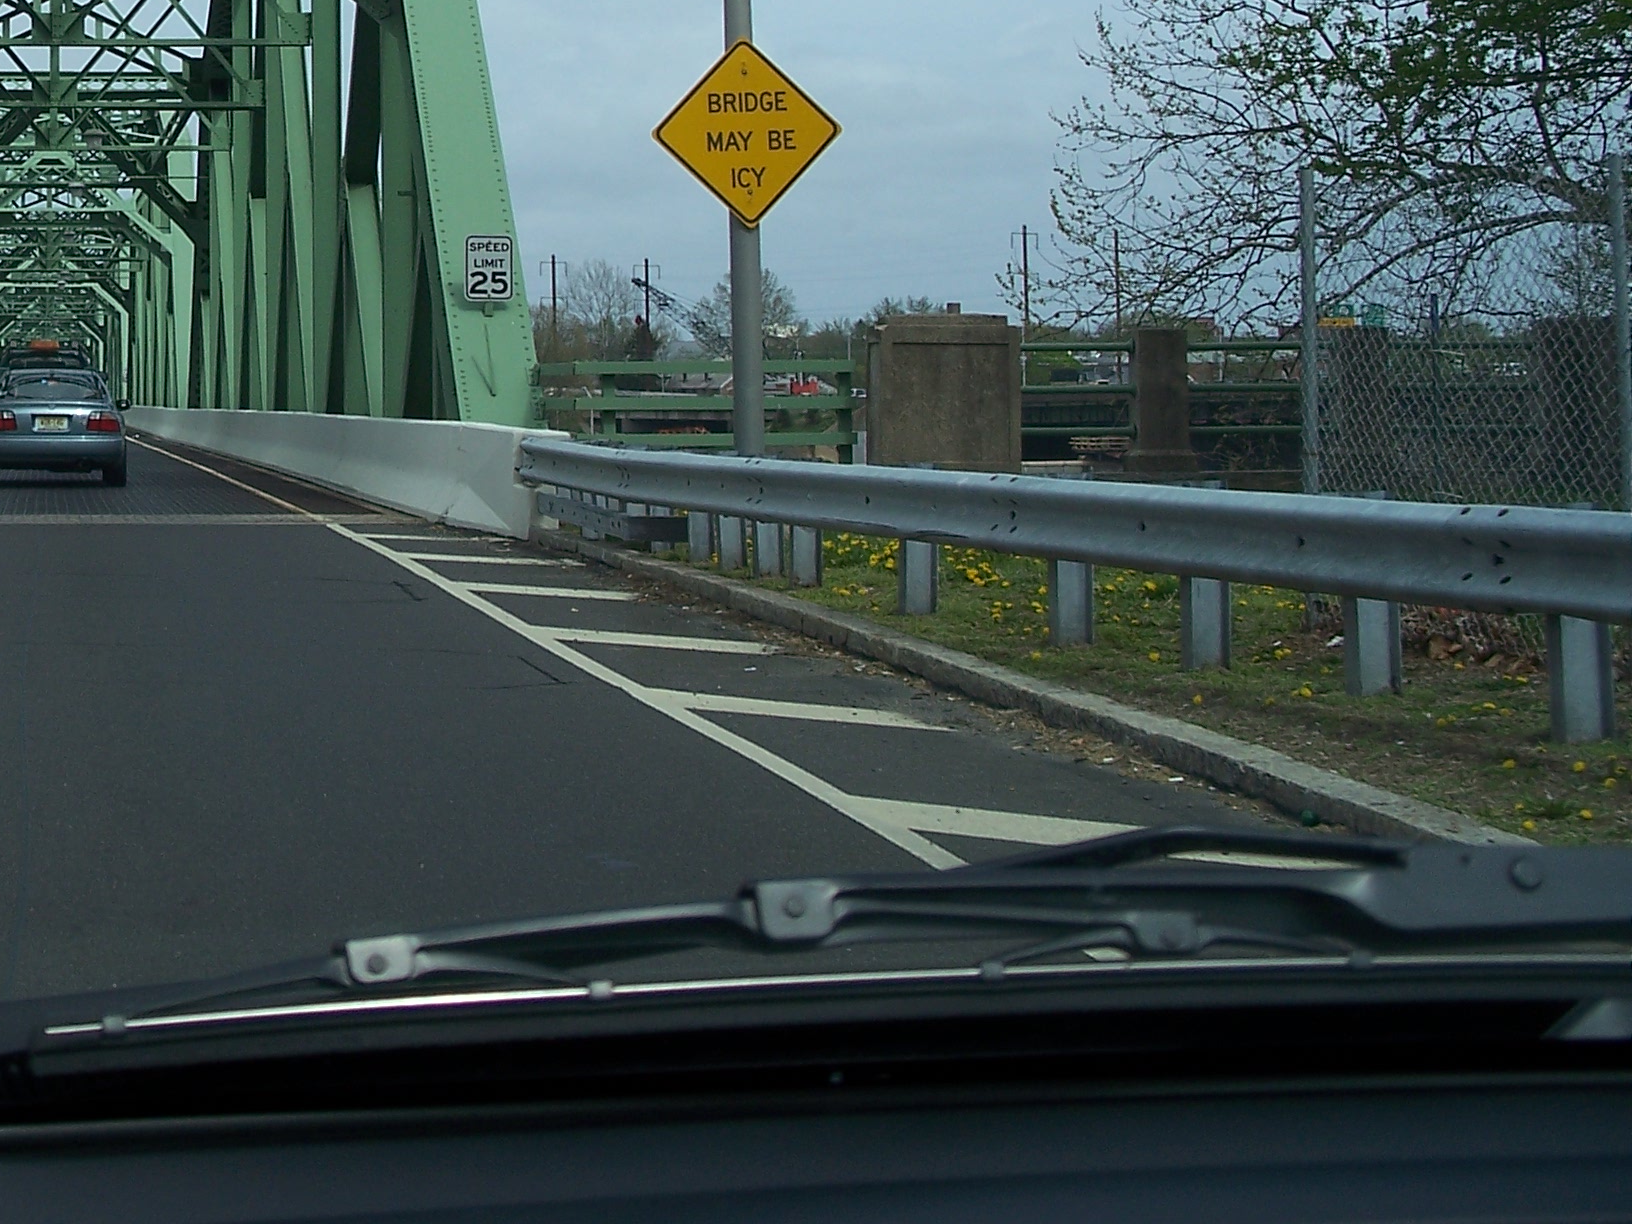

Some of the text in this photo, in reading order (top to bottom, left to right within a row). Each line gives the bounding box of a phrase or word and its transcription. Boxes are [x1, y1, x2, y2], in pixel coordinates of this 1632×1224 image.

[707, 91, 788, 113] BRIDGE
[706, 130, 797, 152] MAY BE
[731, 167, 765, 188] ICY
[469, 242, 509, 252] SPEED
[474, 258, 505, 268] LIMIT
[469, 271, 508, 294] 25
